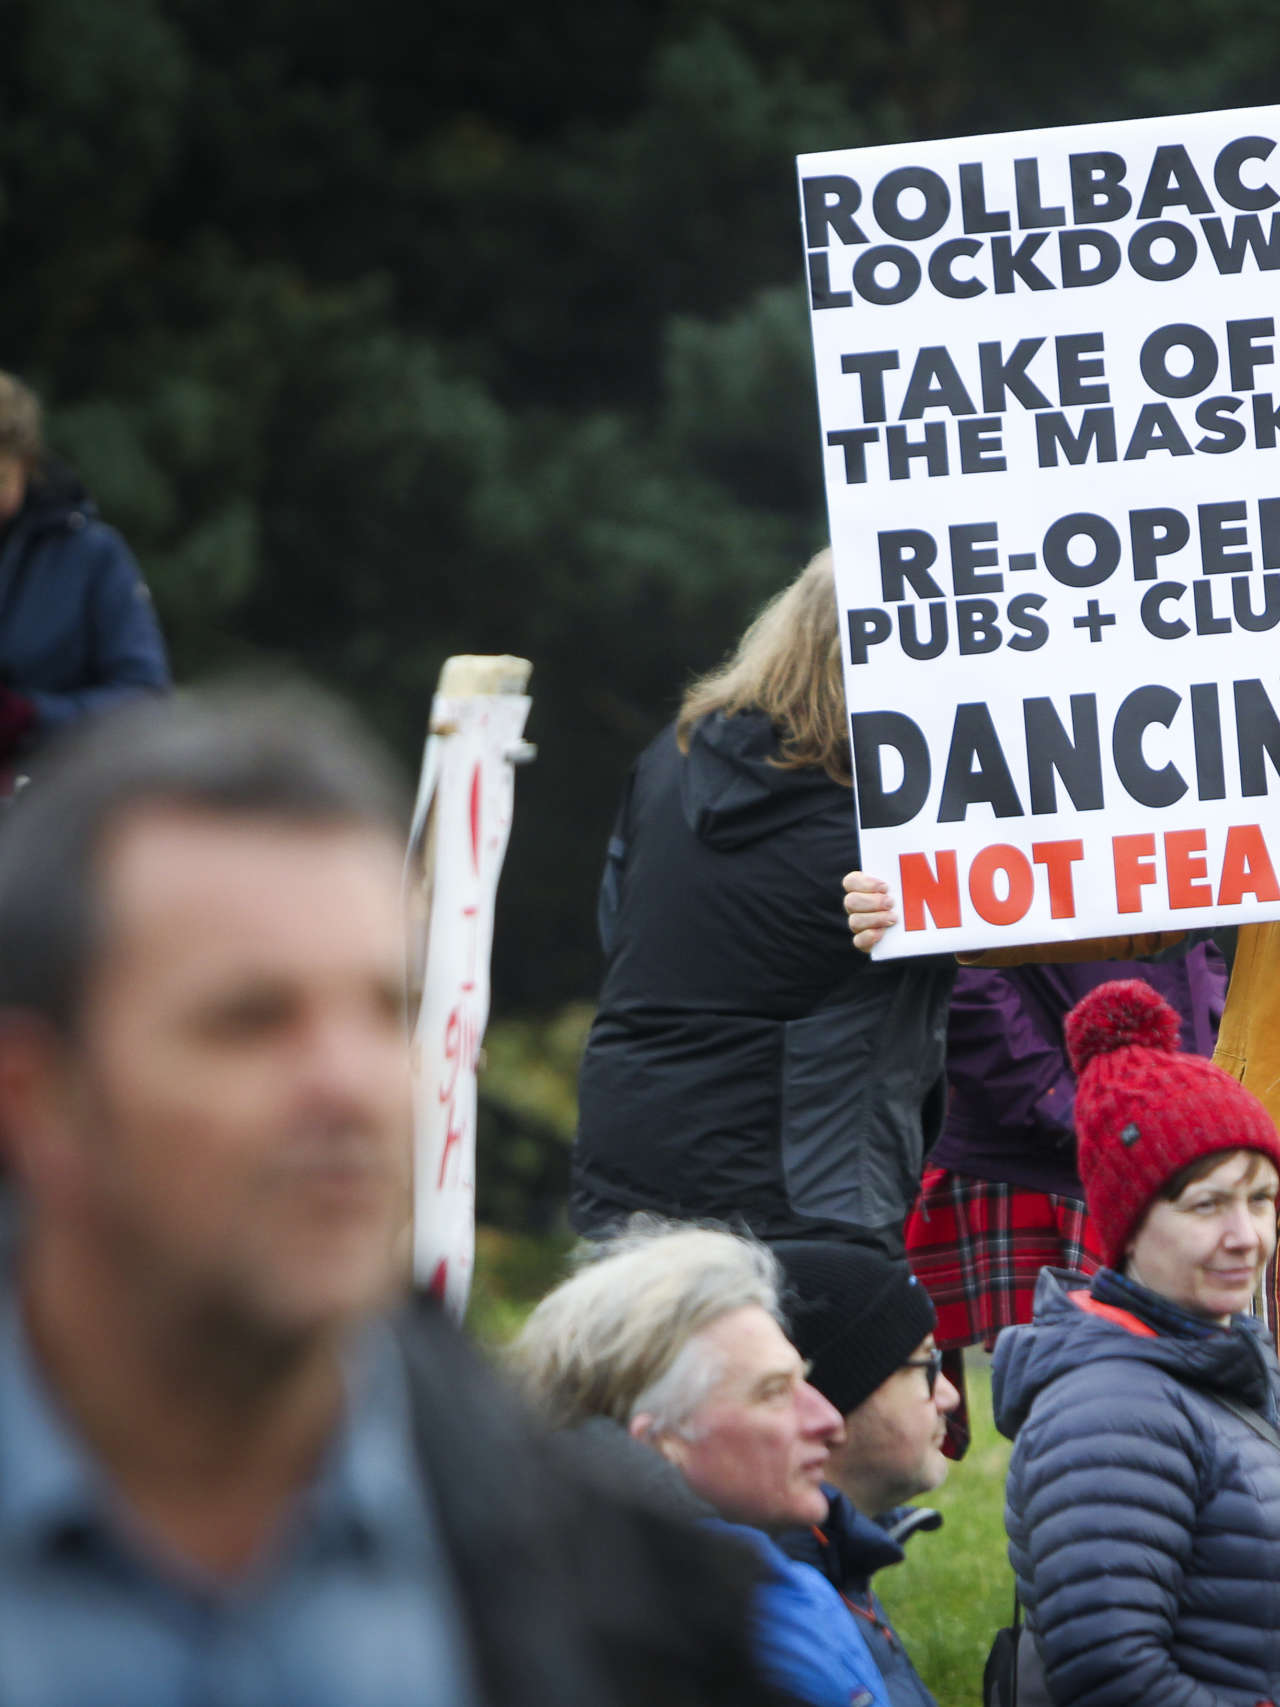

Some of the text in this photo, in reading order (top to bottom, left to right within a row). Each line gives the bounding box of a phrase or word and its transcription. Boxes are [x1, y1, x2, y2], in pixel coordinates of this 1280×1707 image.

[841, 332, 1111, 424] TAKE
[827, 417, 1007, 485] THE
[847, 593, 1049, 665] PUBS
[1073, 600, 1116, 643] +
[898, 839, 1084, 932] NOT
